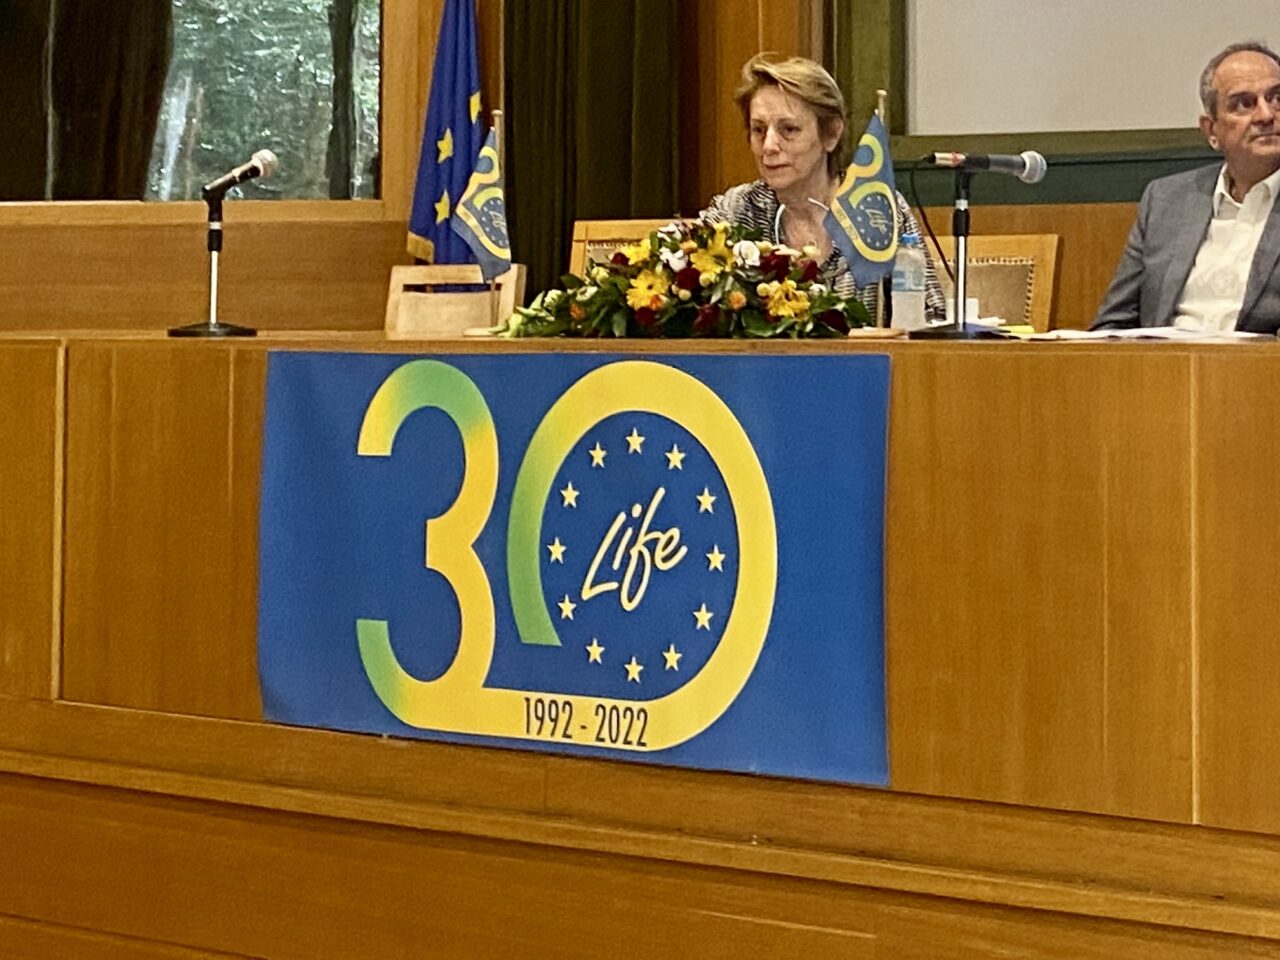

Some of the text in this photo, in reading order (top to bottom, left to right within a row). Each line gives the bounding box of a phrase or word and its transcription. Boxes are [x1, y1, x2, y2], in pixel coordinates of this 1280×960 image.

[356, 358, 778, 752] 30
[581, 487, 688, 611] Life
[524, 696, 573, 739] 1992
[594, 703, 649, 747] 2022
